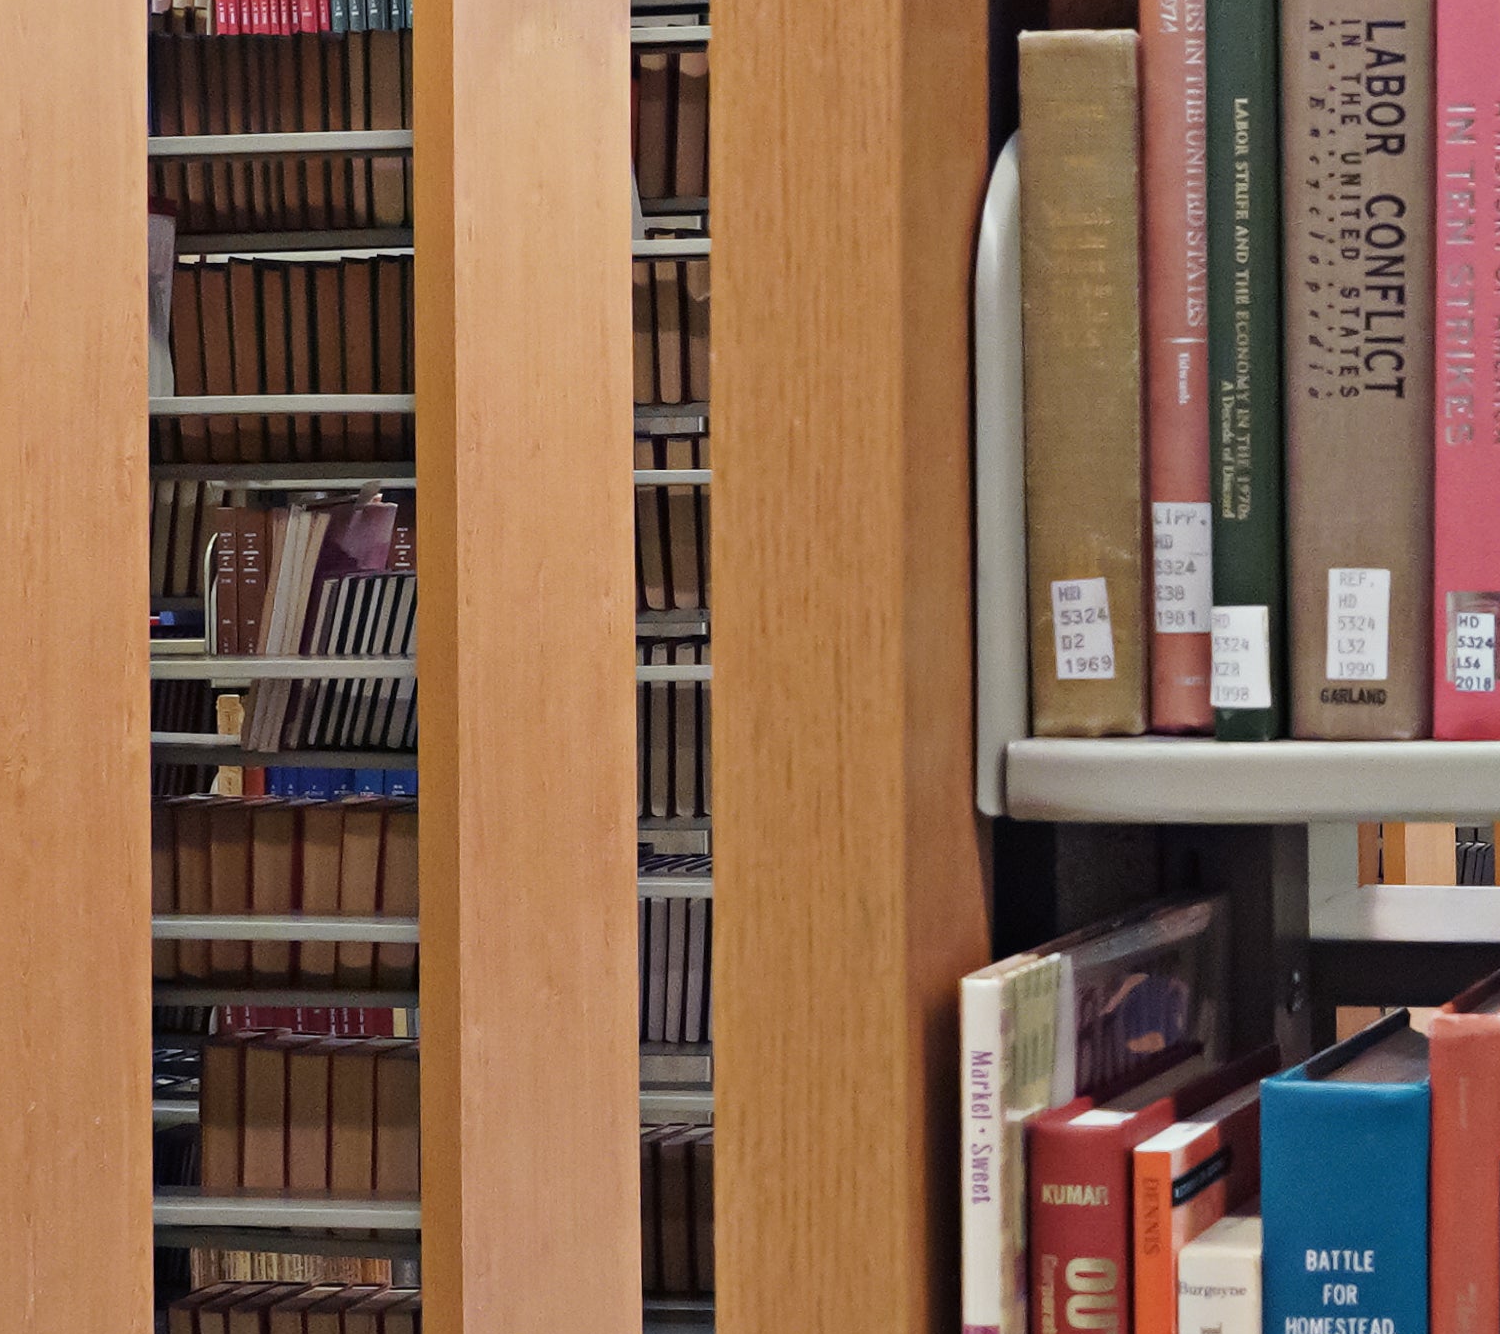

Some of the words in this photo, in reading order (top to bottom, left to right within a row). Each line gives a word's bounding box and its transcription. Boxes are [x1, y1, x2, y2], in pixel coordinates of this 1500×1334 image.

[1340, 19, 1362, 47] IN
[1340, 73, 1362, 126] THE
[1364, 19, 1407, 158] LABOR
[1339, 152, 1362, 261] UNITED
[1363, 193, 1408, 399] CONFLICT
[1338, 286, 1362, 399] STATES
[1320, 688, 1387, 707] GARLAND
[1041, 1183, 1109, 1207] KUMAR
[1305, 1249, 1375, 1273] BATTLE
[1322, 1283, 1359, 1306] FOR
